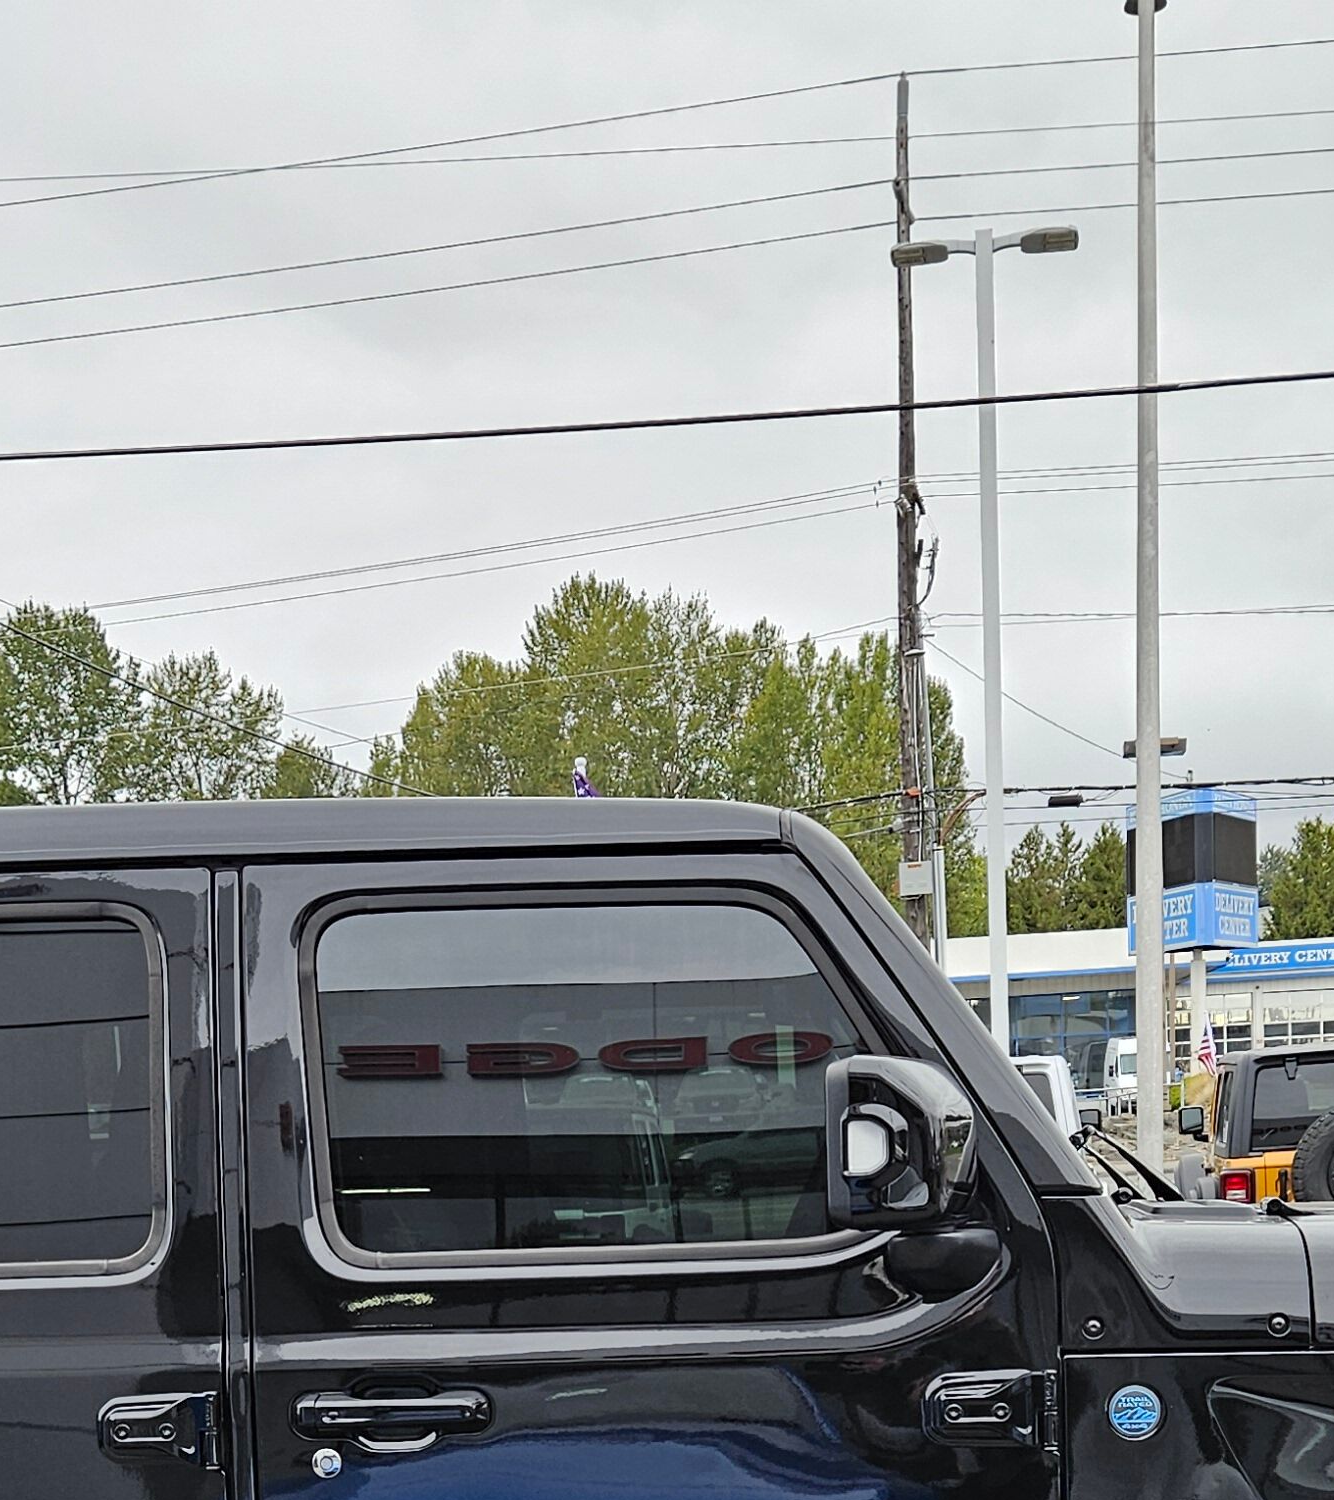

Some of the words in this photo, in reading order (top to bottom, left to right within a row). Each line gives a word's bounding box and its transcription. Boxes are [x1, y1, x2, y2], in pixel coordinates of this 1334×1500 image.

[1215, 893, 1254, 916] DELIVERY
[1218, 916, 1252, 937] CENTER
[1226, 951, 1292, 967] ELIVERY
